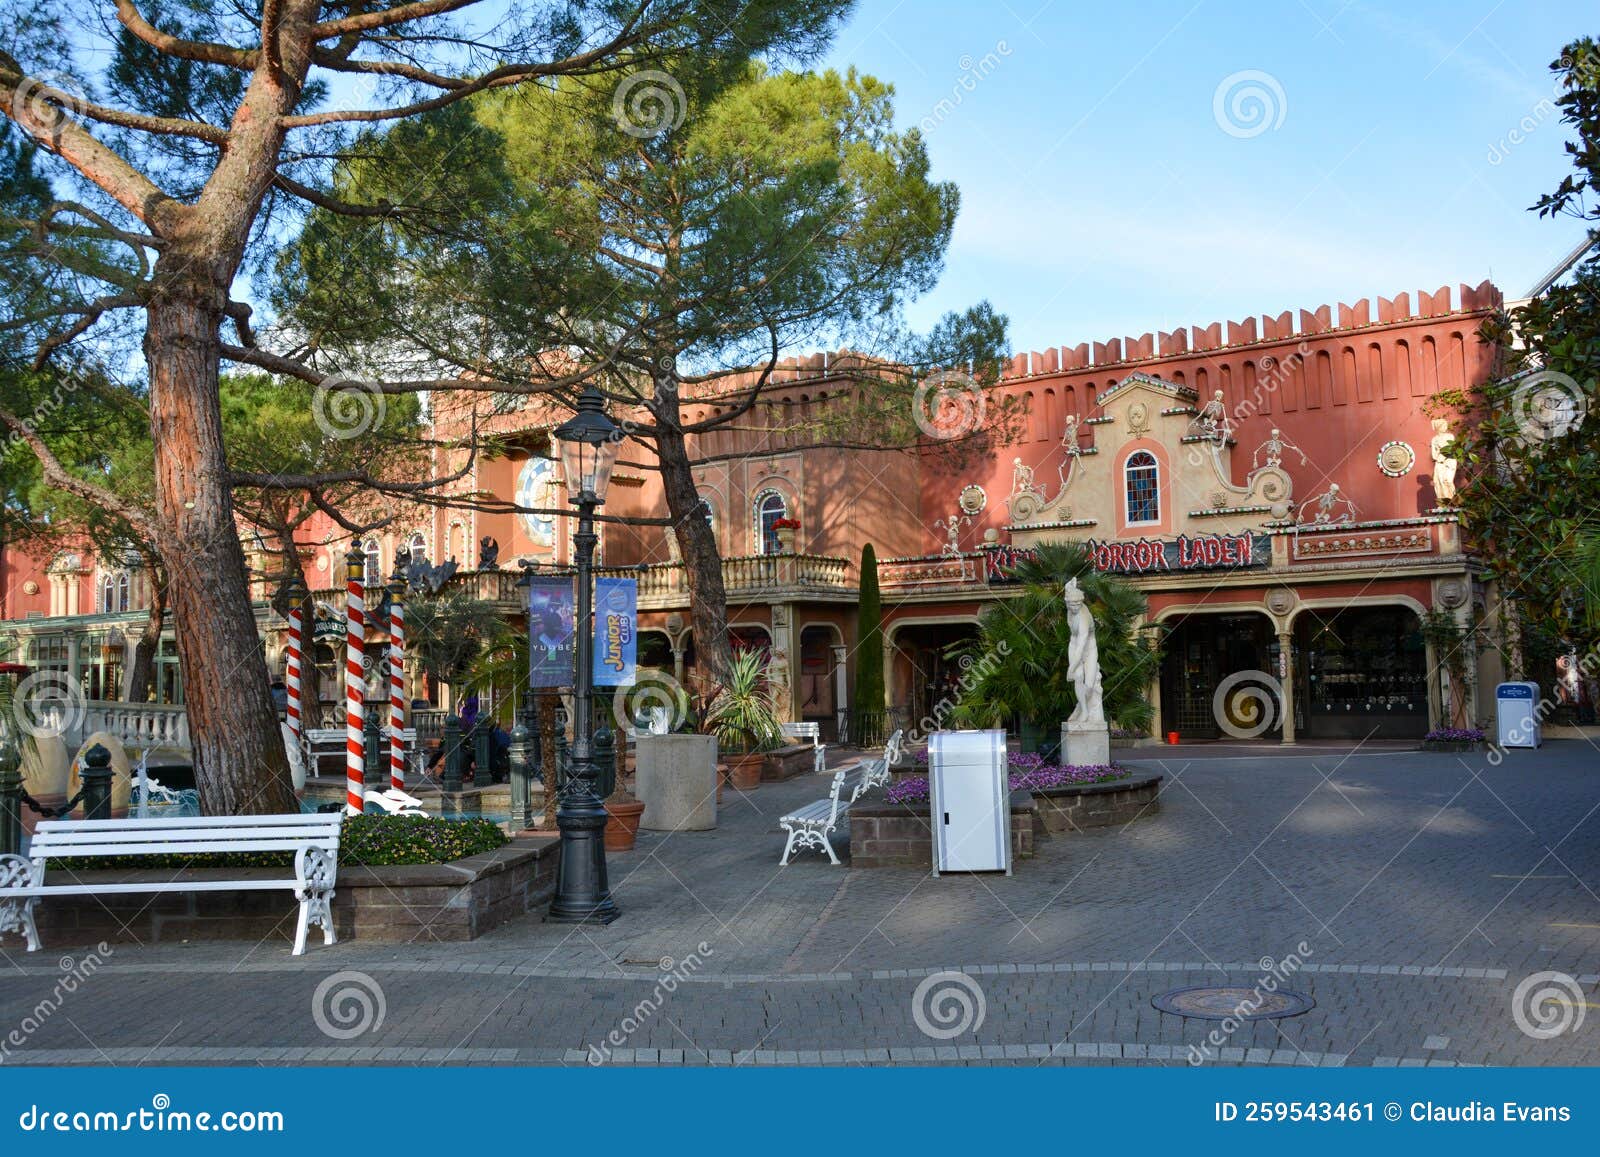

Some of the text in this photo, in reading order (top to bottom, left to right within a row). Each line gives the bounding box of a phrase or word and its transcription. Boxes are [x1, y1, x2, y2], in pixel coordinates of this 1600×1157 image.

[1177, 530, 1252, 568] LADEN
[604, 614, 624, 671] JUNIOR
[620, 615, 630, 644] CLUB
